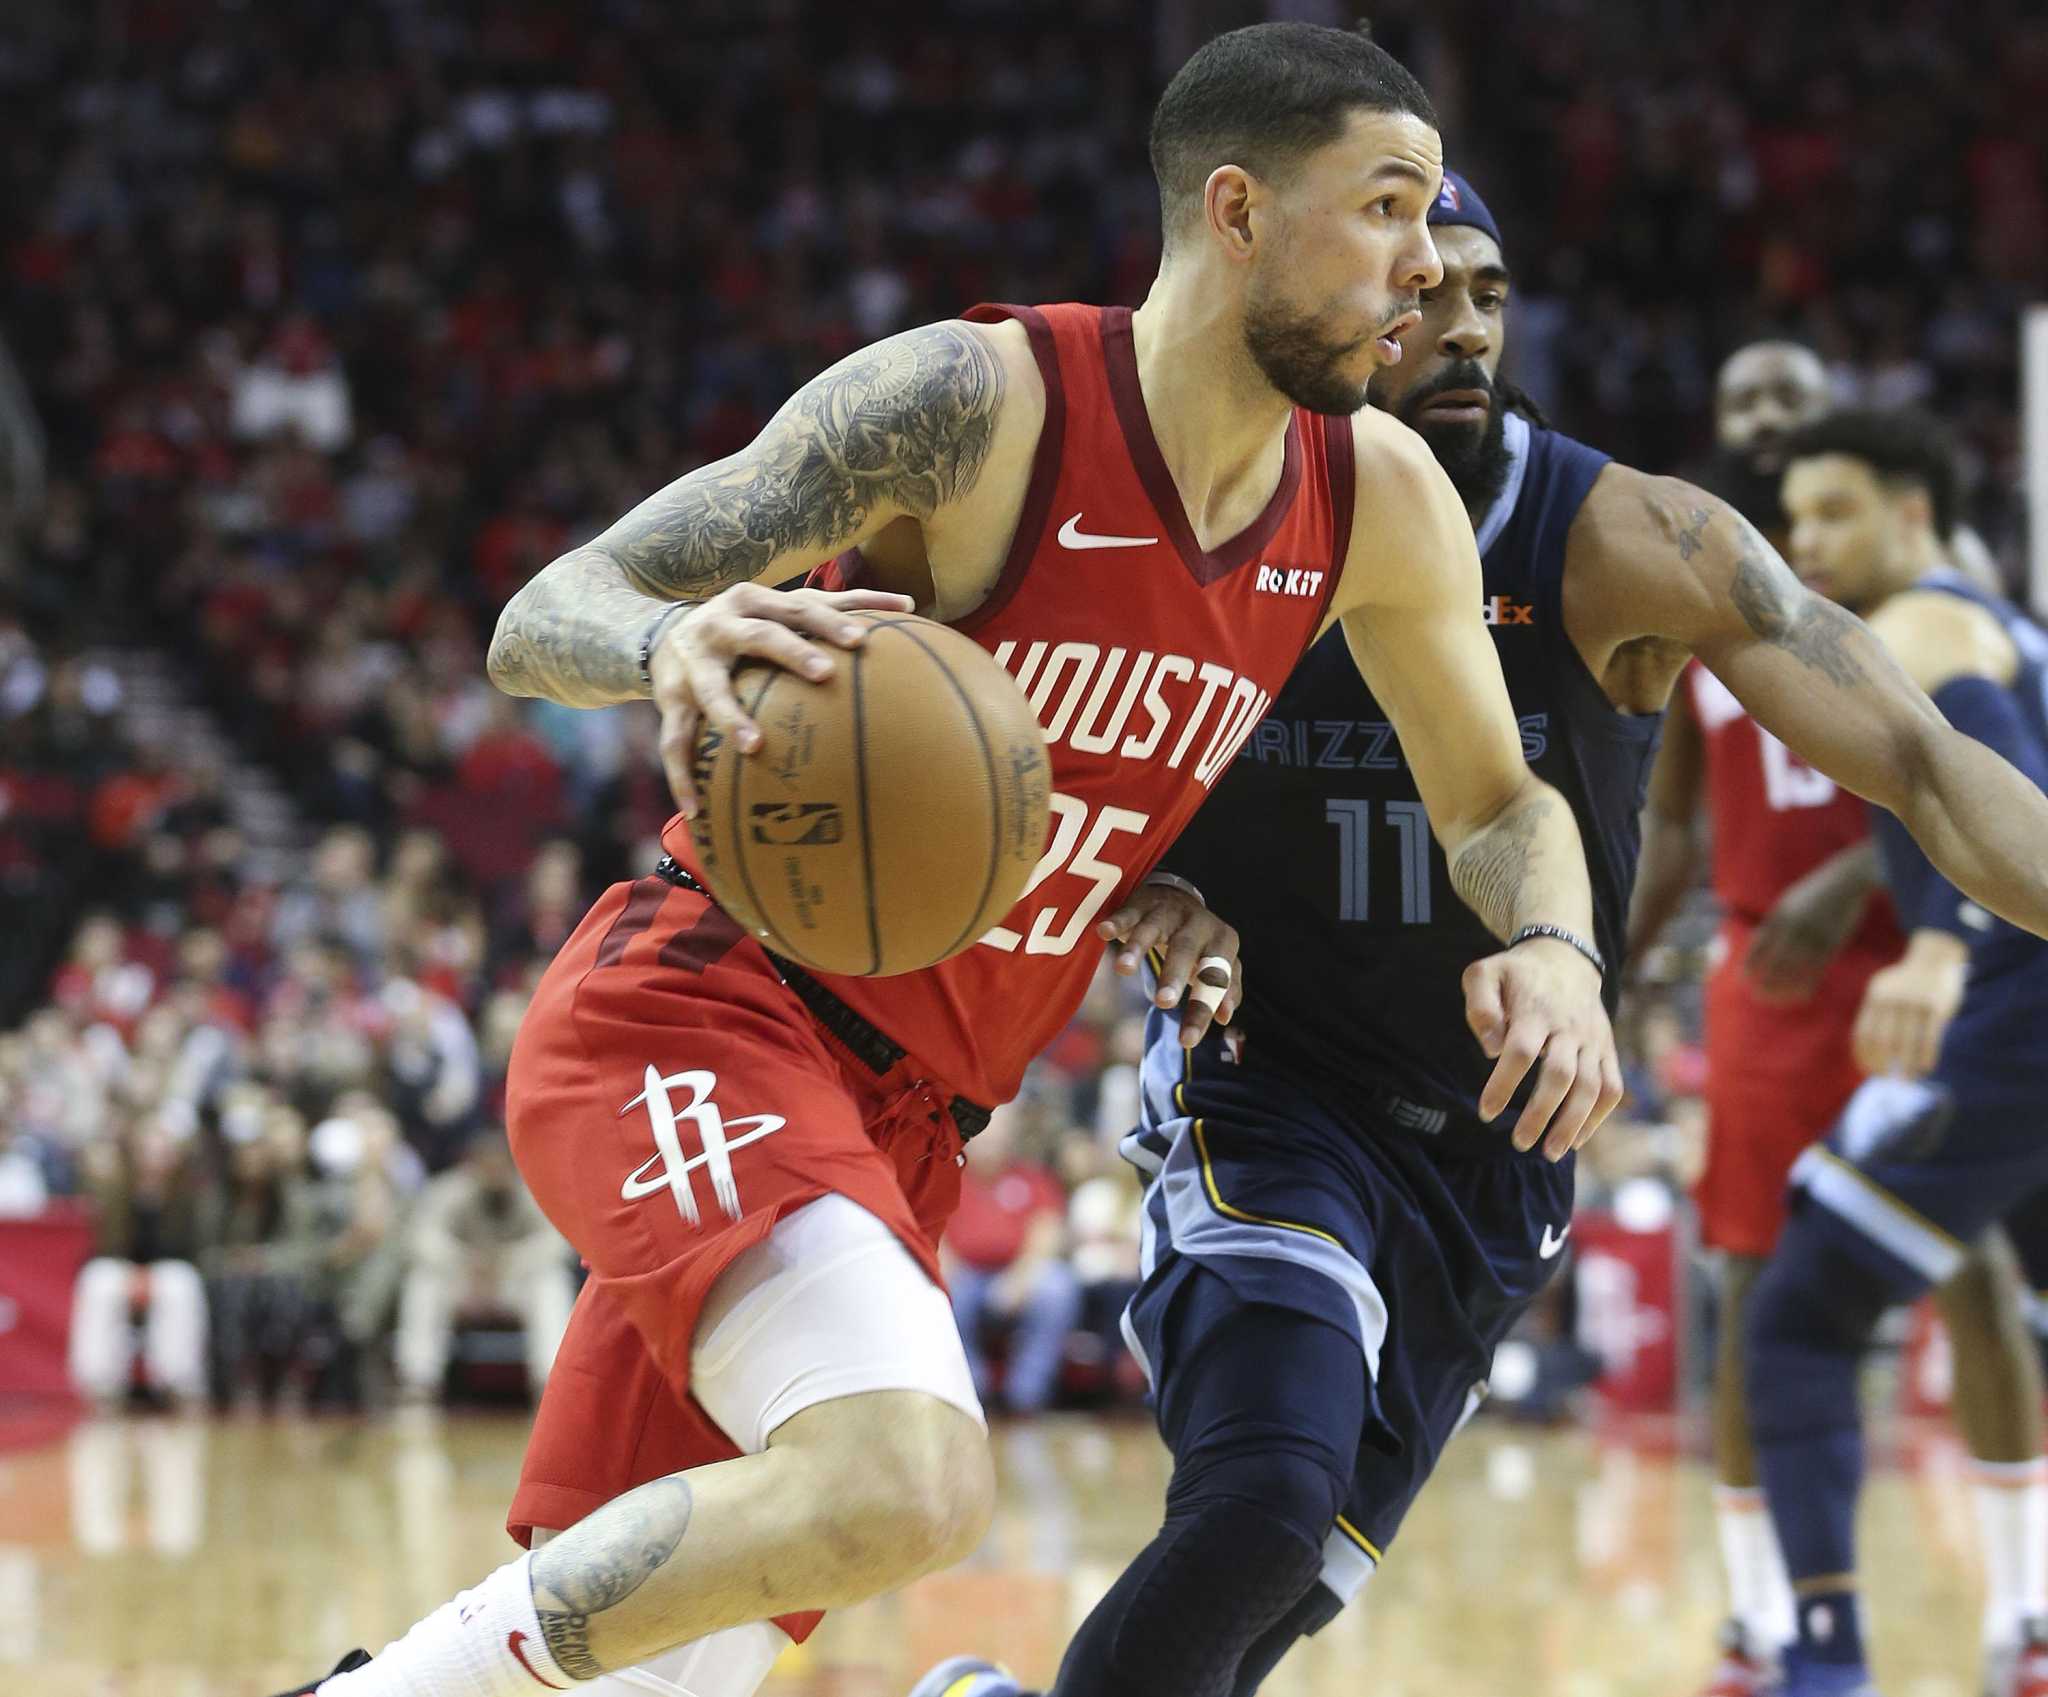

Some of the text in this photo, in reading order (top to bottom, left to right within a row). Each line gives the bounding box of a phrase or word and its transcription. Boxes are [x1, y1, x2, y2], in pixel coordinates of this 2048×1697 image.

[1483, 596, 1533, 625] dEx
[1238, 713, 1548, 770] RIZZS
[1325, 799, 1431, 924] 11
